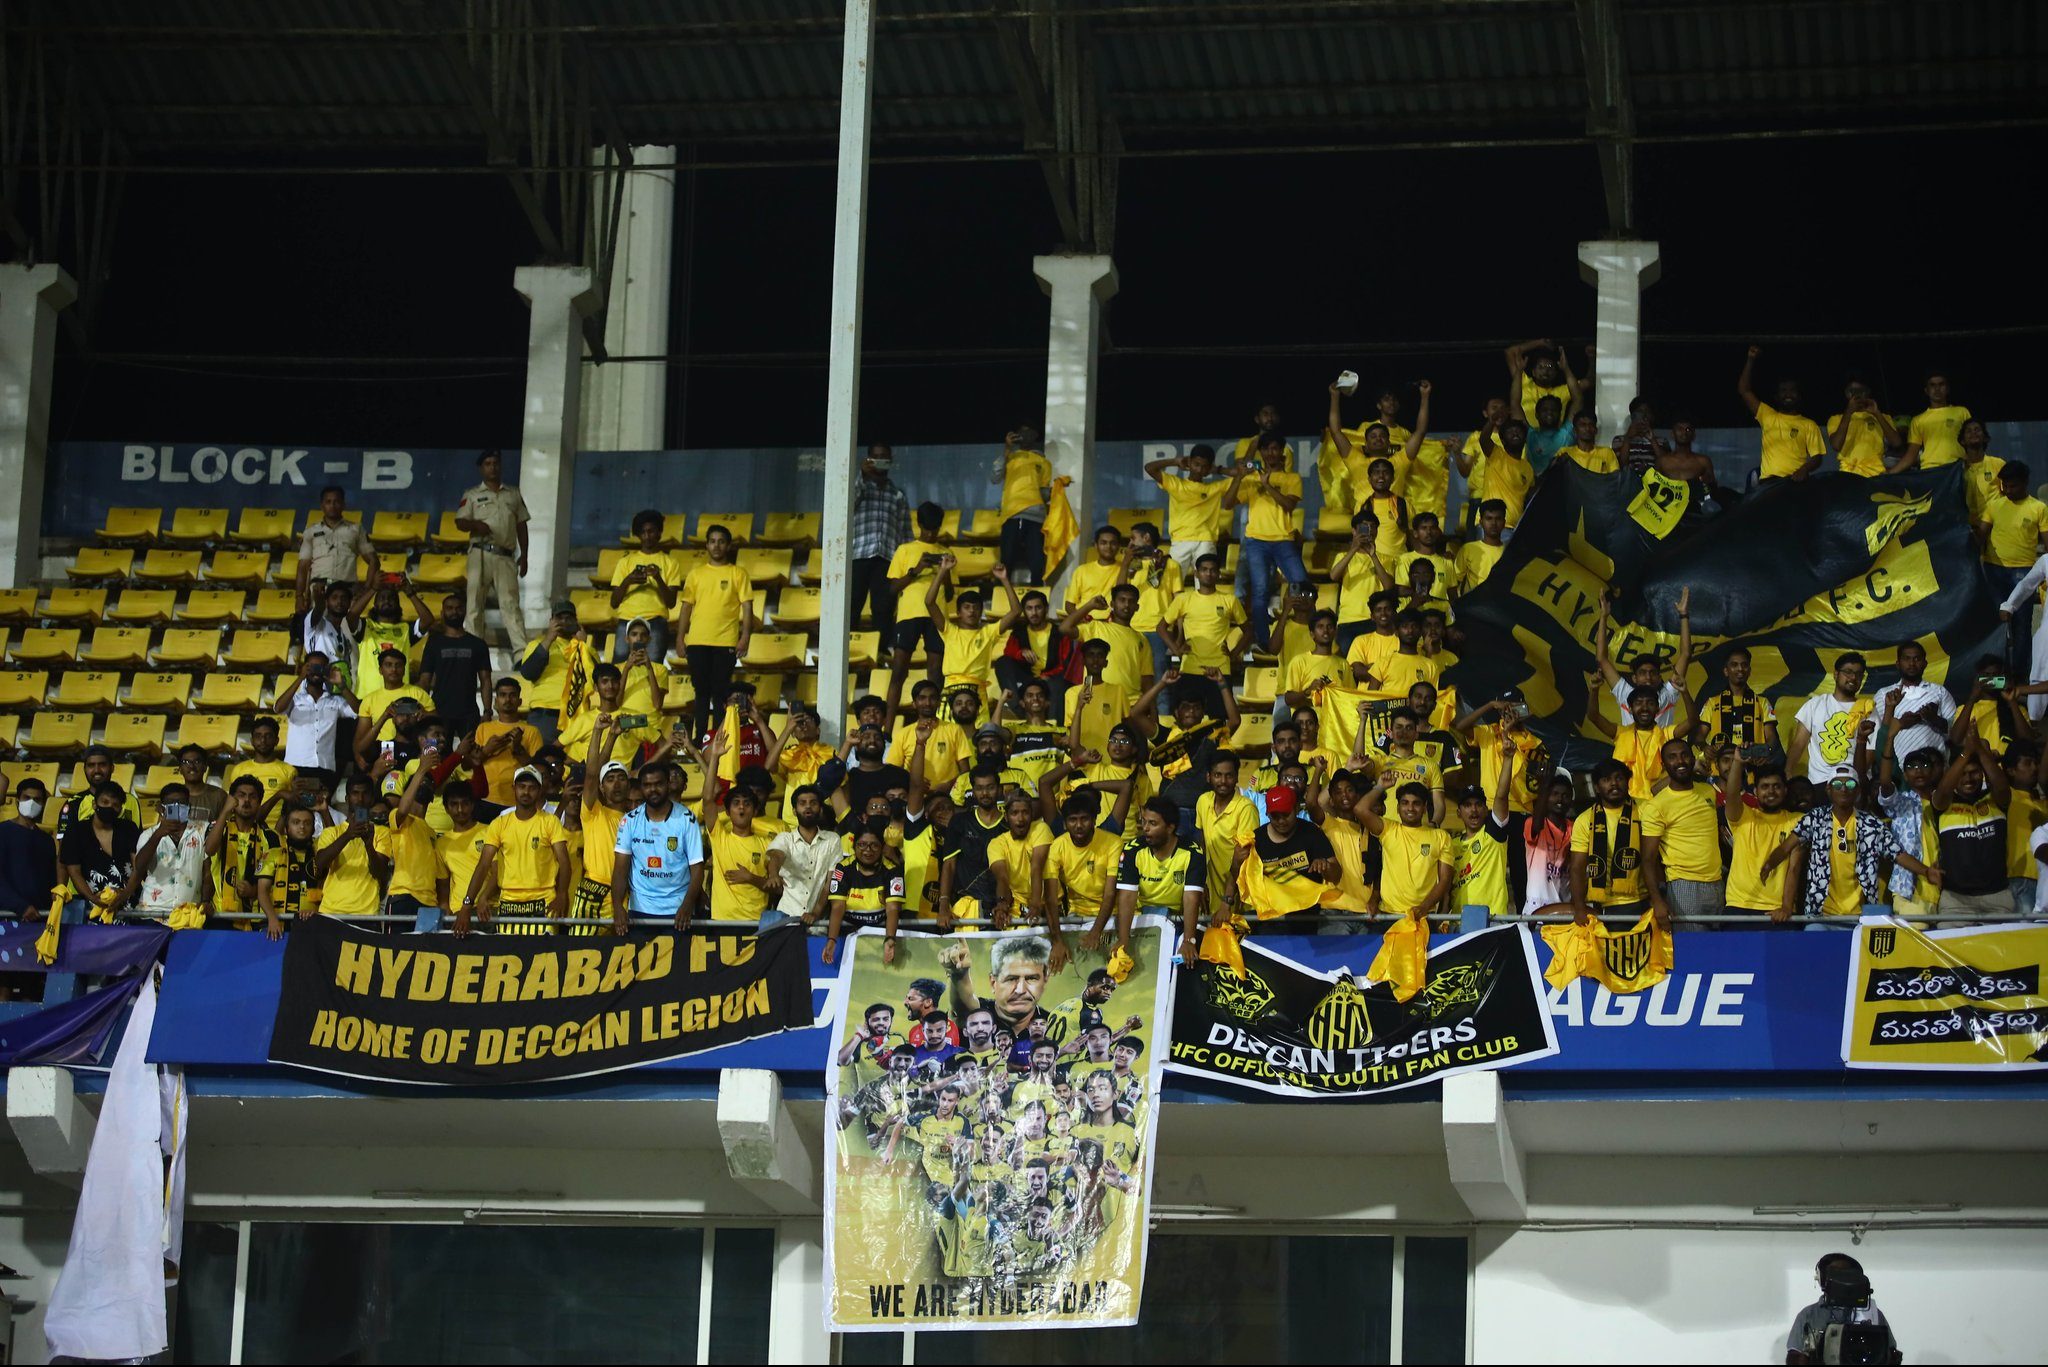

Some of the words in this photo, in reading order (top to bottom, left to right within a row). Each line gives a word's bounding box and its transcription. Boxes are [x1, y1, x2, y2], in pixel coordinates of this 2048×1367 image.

[121, 445, 309, 486] BLOCK
[361, 450, 414, 490] B
[157, 675, 174, 683] 25
[132, 716, 149, 725] 24
[1250, 716, 1267, 725] 37
[334, 936, 675, 1003] HYDERABAD
[309, 1009, 412, 1060] HOME
[419, 1028, 470, 1065] OF
[474, 1010, 631, 1067] DECCAN
[639, 977, 771, 1042] LEGION
[1405, 1050, 1451, 1077] FAN
[1456, 1035, 1519, 1062] CLUB
[869, 1284, 905, 1318] WE
[913, 1283, 960, 1317] ARE
